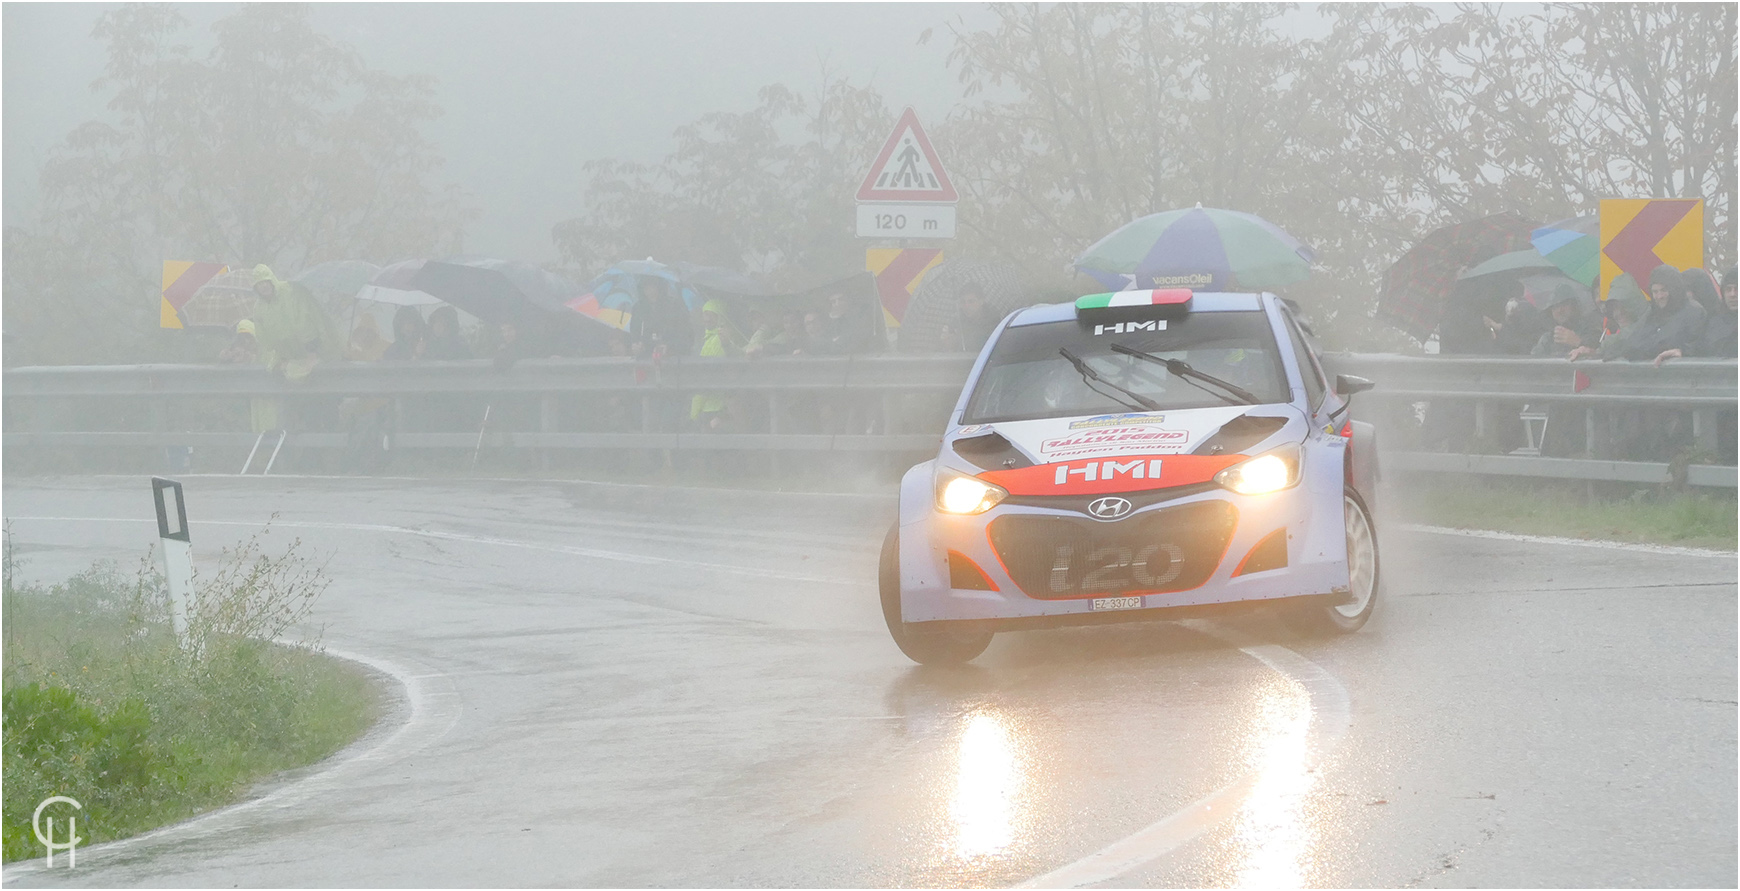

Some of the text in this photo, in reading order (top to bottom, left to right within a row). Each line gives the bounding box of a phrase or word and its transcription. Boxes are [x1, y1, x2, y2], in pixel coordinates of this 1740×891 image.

[875, 214, 938, 230] 120 m
[1094, 319, 1168, 336] HMI
[1085, 427, 1146, 436] 2015
[1047, 432, 1184, 448] RALLYLEGEND
[1050, 447, 1113, 457] Hayden
[1054, 459, 1163, 485] HMI
[1051, 543, 1185, 592] i20
